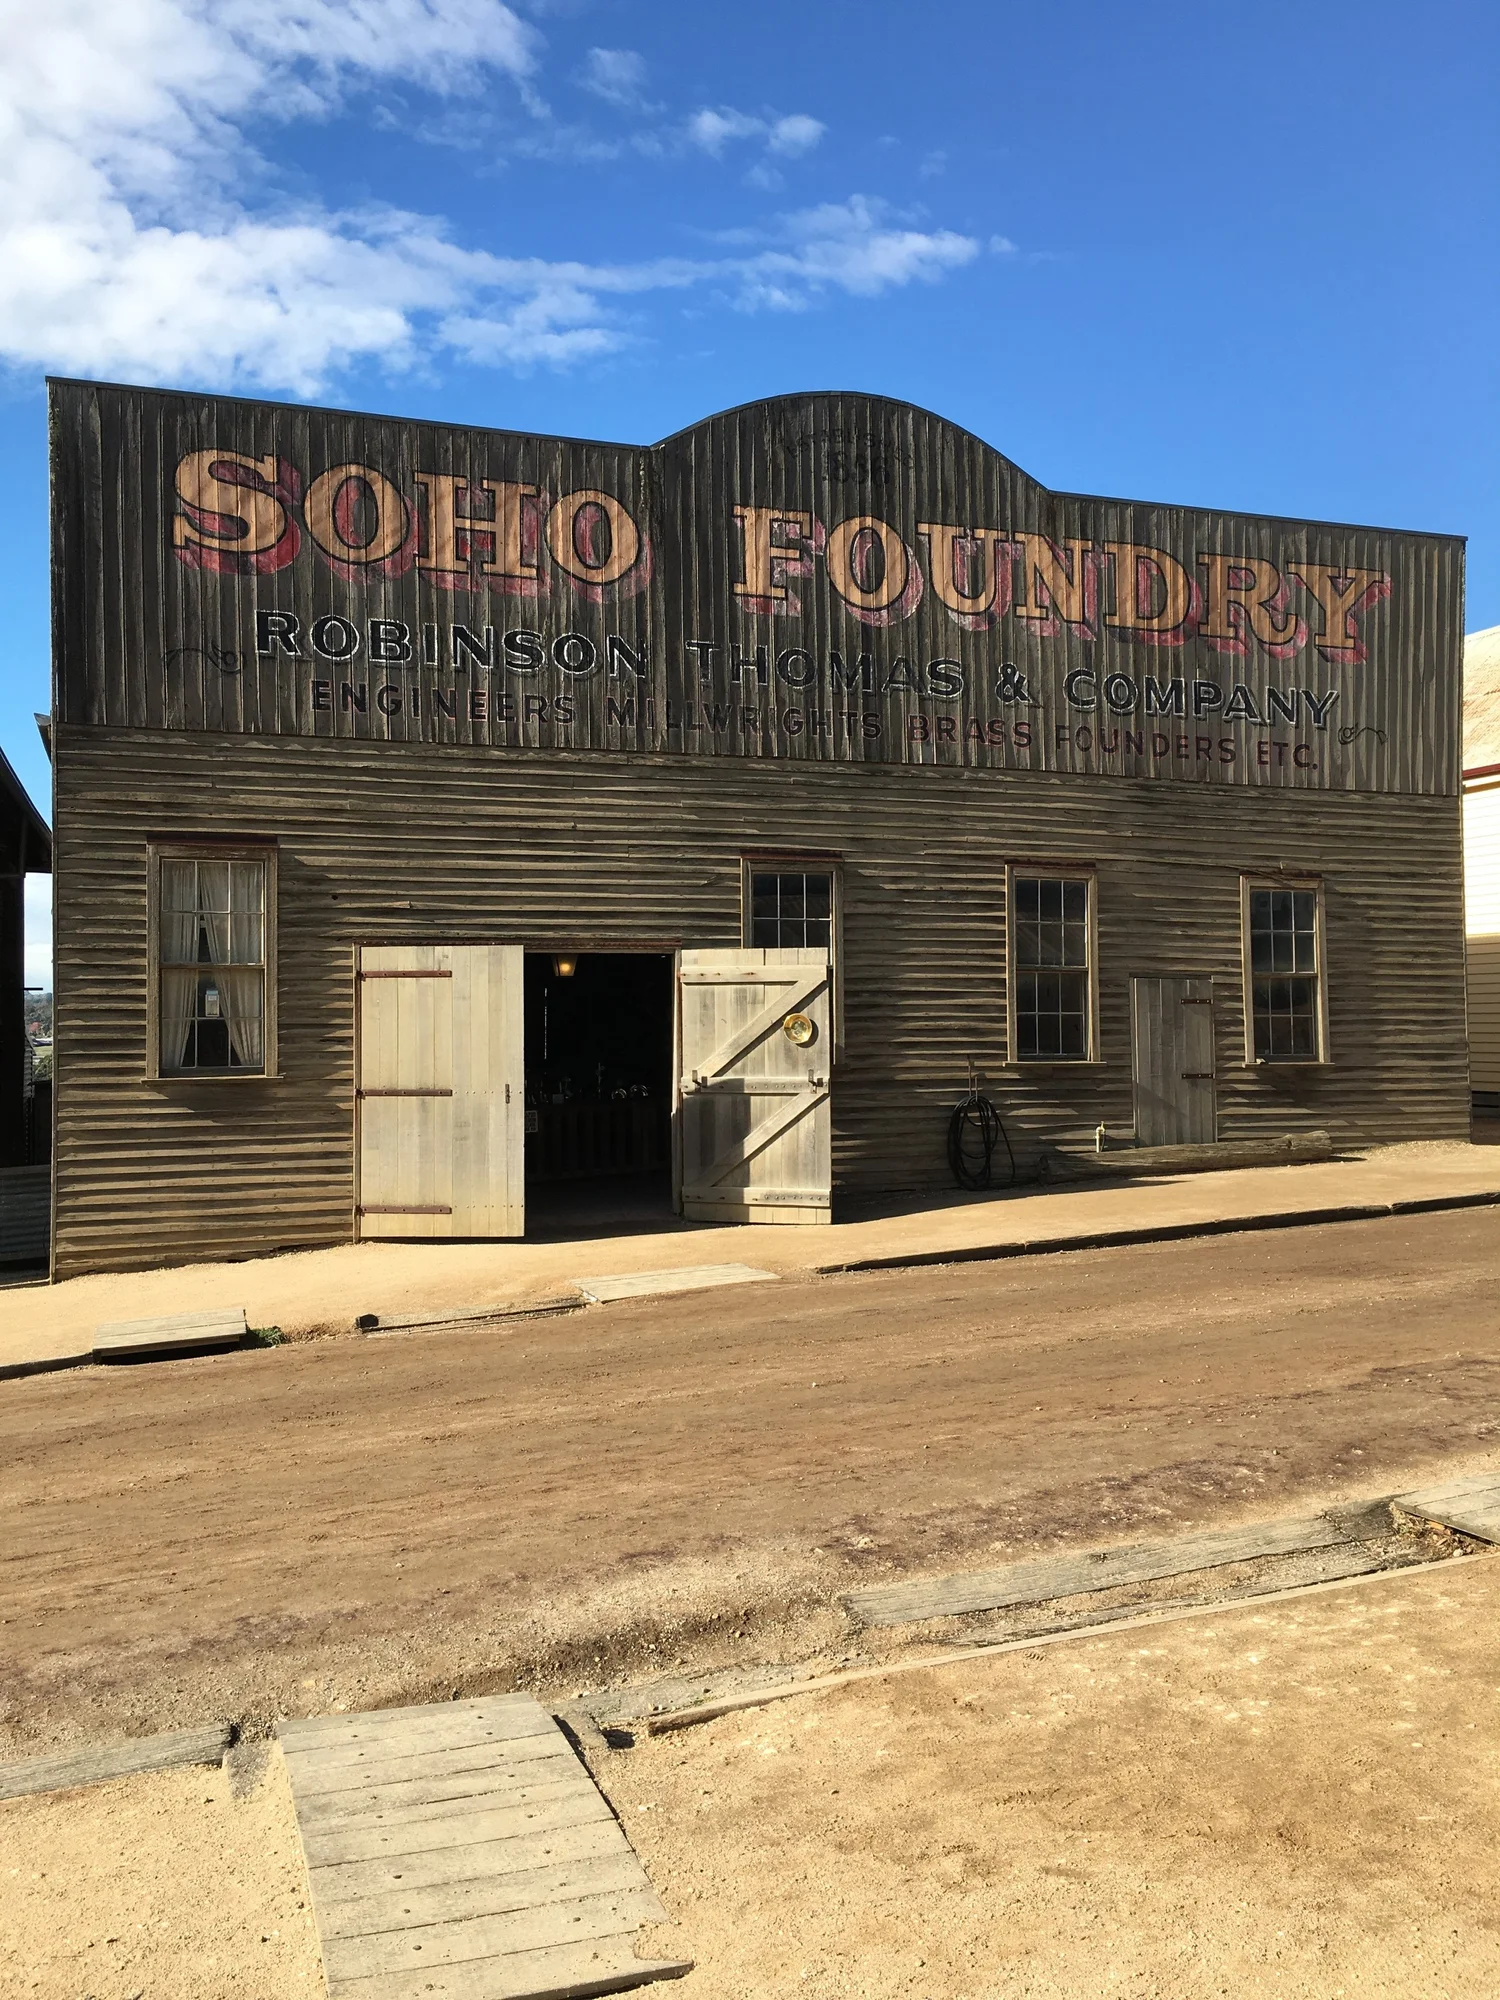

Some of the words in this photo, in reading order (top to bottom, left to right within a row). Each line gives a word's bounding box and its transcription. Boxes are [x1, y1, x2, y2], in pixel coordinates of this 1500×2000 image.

[172, 447, 653, 603] SOHO
[732, 503, 1392, 664] FOUNDRY
[256, 609, 648, 679] ROBINSON
[686, 639, 965, 699] THOMAS
[995, 661, 1033, 705] &
[1063, 667, 1340, 729] COMPANY
[311, 680, 576, 725] ENGINEERS
[606, 695, 882, 741] MILLWRIGHTS
[908, 713, 1033, 749] BRASS
[1055, 724, 1237, 764] FOUNDERS
[1256, 740, 1320, 771] ETC.
